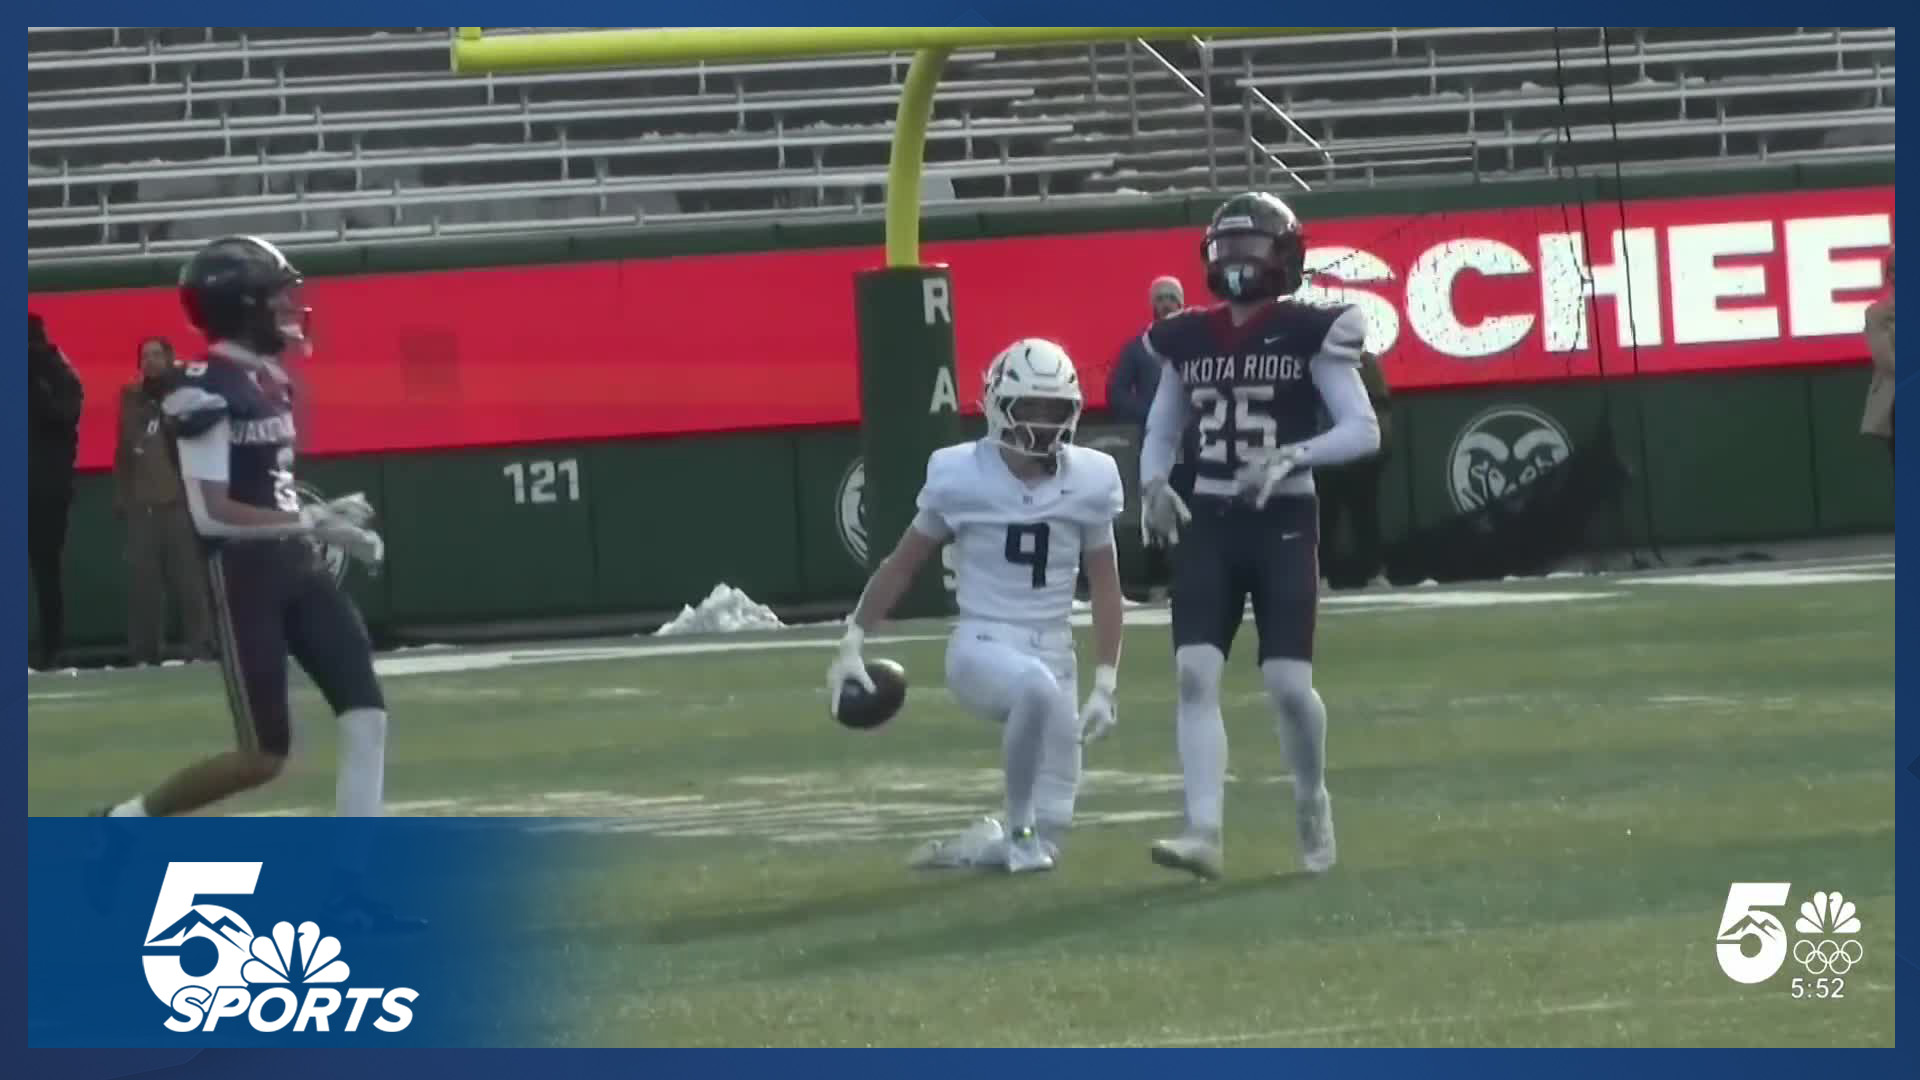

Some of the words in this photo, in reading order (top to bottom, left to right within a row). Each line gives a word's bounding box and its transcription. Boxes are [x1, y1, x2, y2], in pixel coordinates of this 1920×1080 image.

[1183, 355, 1235, 382] KOTA
[1191, 385, 1277, 464] 25
[503, 458, 579, 504] 121
[1004, 522, 1049, 588] 9
